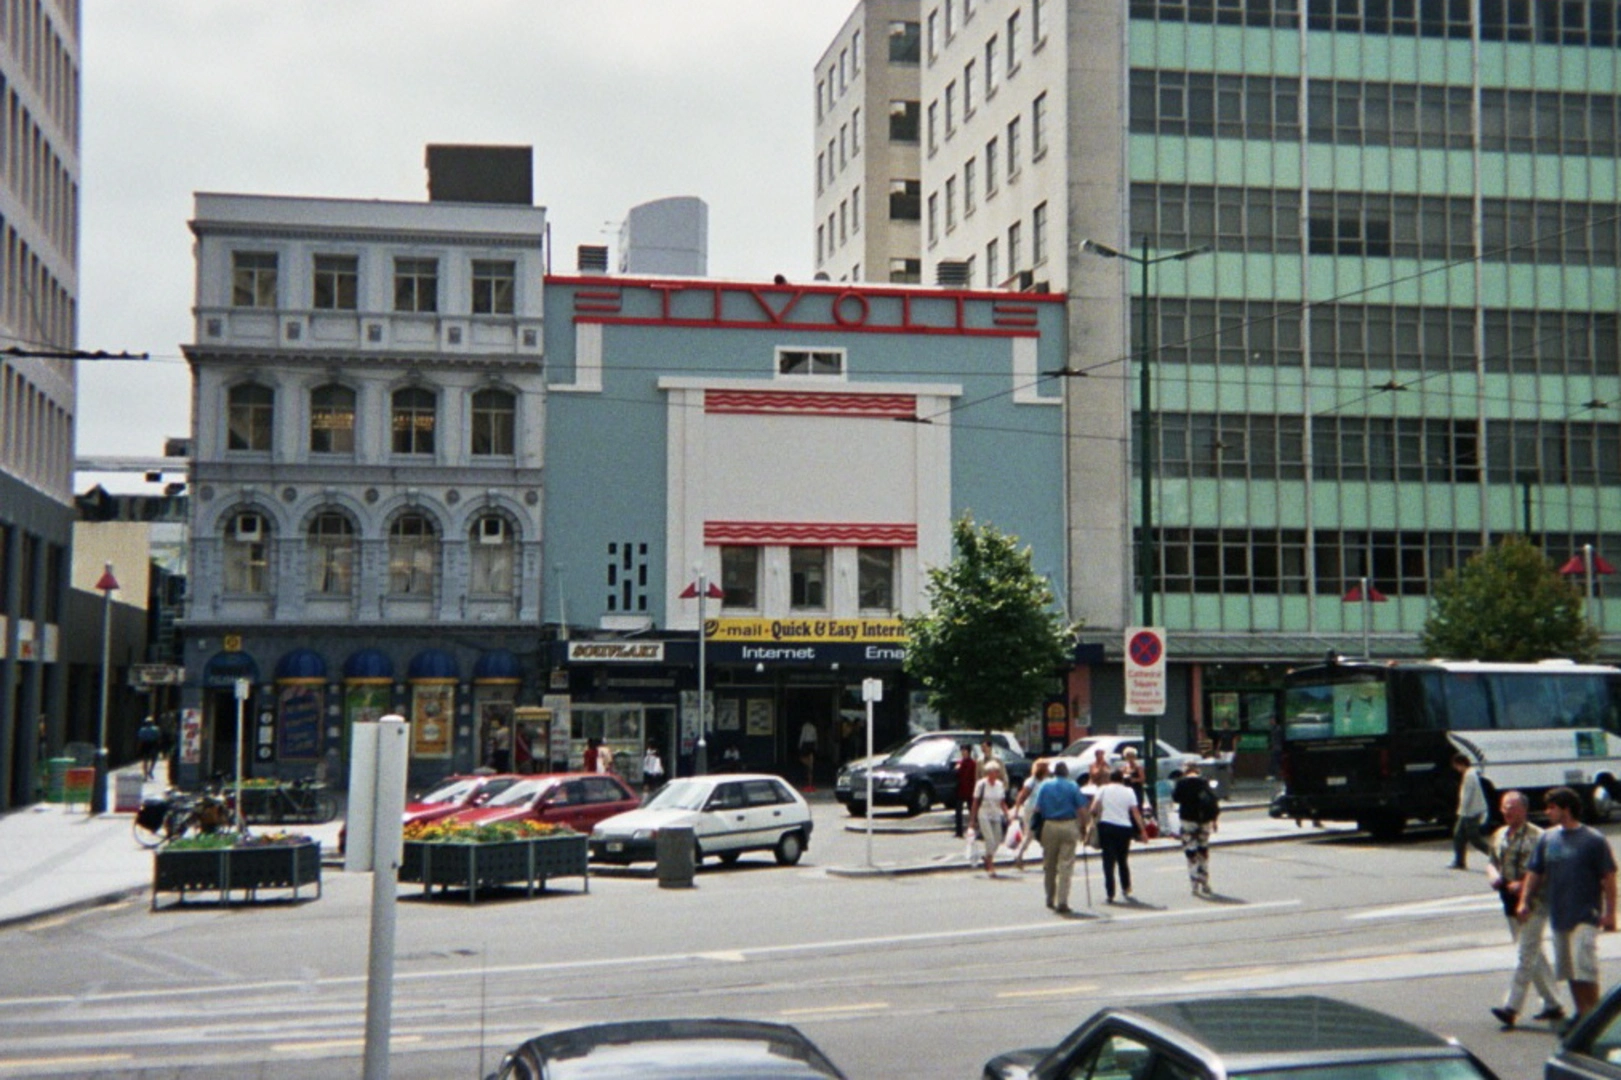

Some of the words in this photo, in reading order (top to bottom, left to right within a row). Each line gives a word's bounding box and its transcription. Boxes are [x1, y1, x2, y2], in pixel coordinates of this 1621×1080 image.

[650, 283, 966, 336] TIVOLI
[771, 620, 811, 640] Quick
[814, 621, 826, 637] &
[828, 620, 859, 640] Easy
[862, 621, 905, 637] Intern
[741, 646, 816, 659] Internet
[865, 646, 905, 660] Ema
